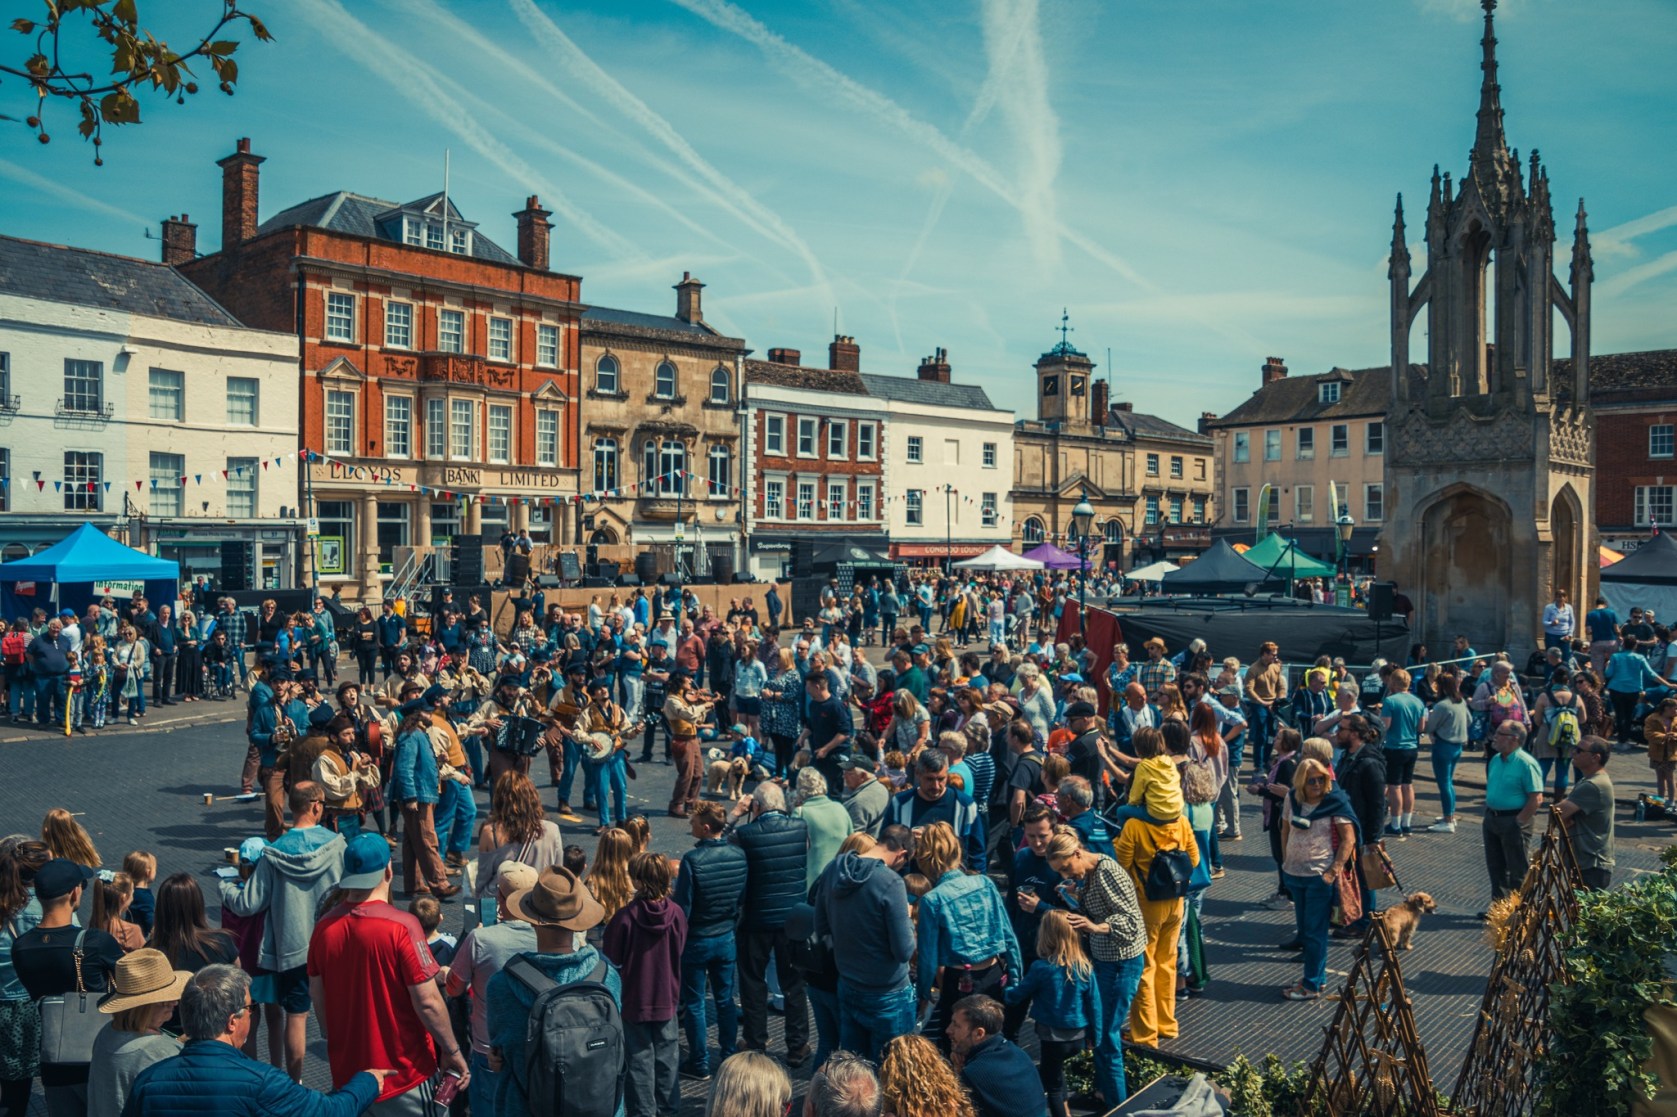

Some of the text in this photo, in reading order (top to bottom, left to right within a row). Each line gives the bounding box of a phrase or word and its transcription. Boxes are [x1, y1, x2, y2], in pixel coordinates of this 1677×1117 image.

[330, 464, 560, 487] LLOYDS BANK LIMITED
